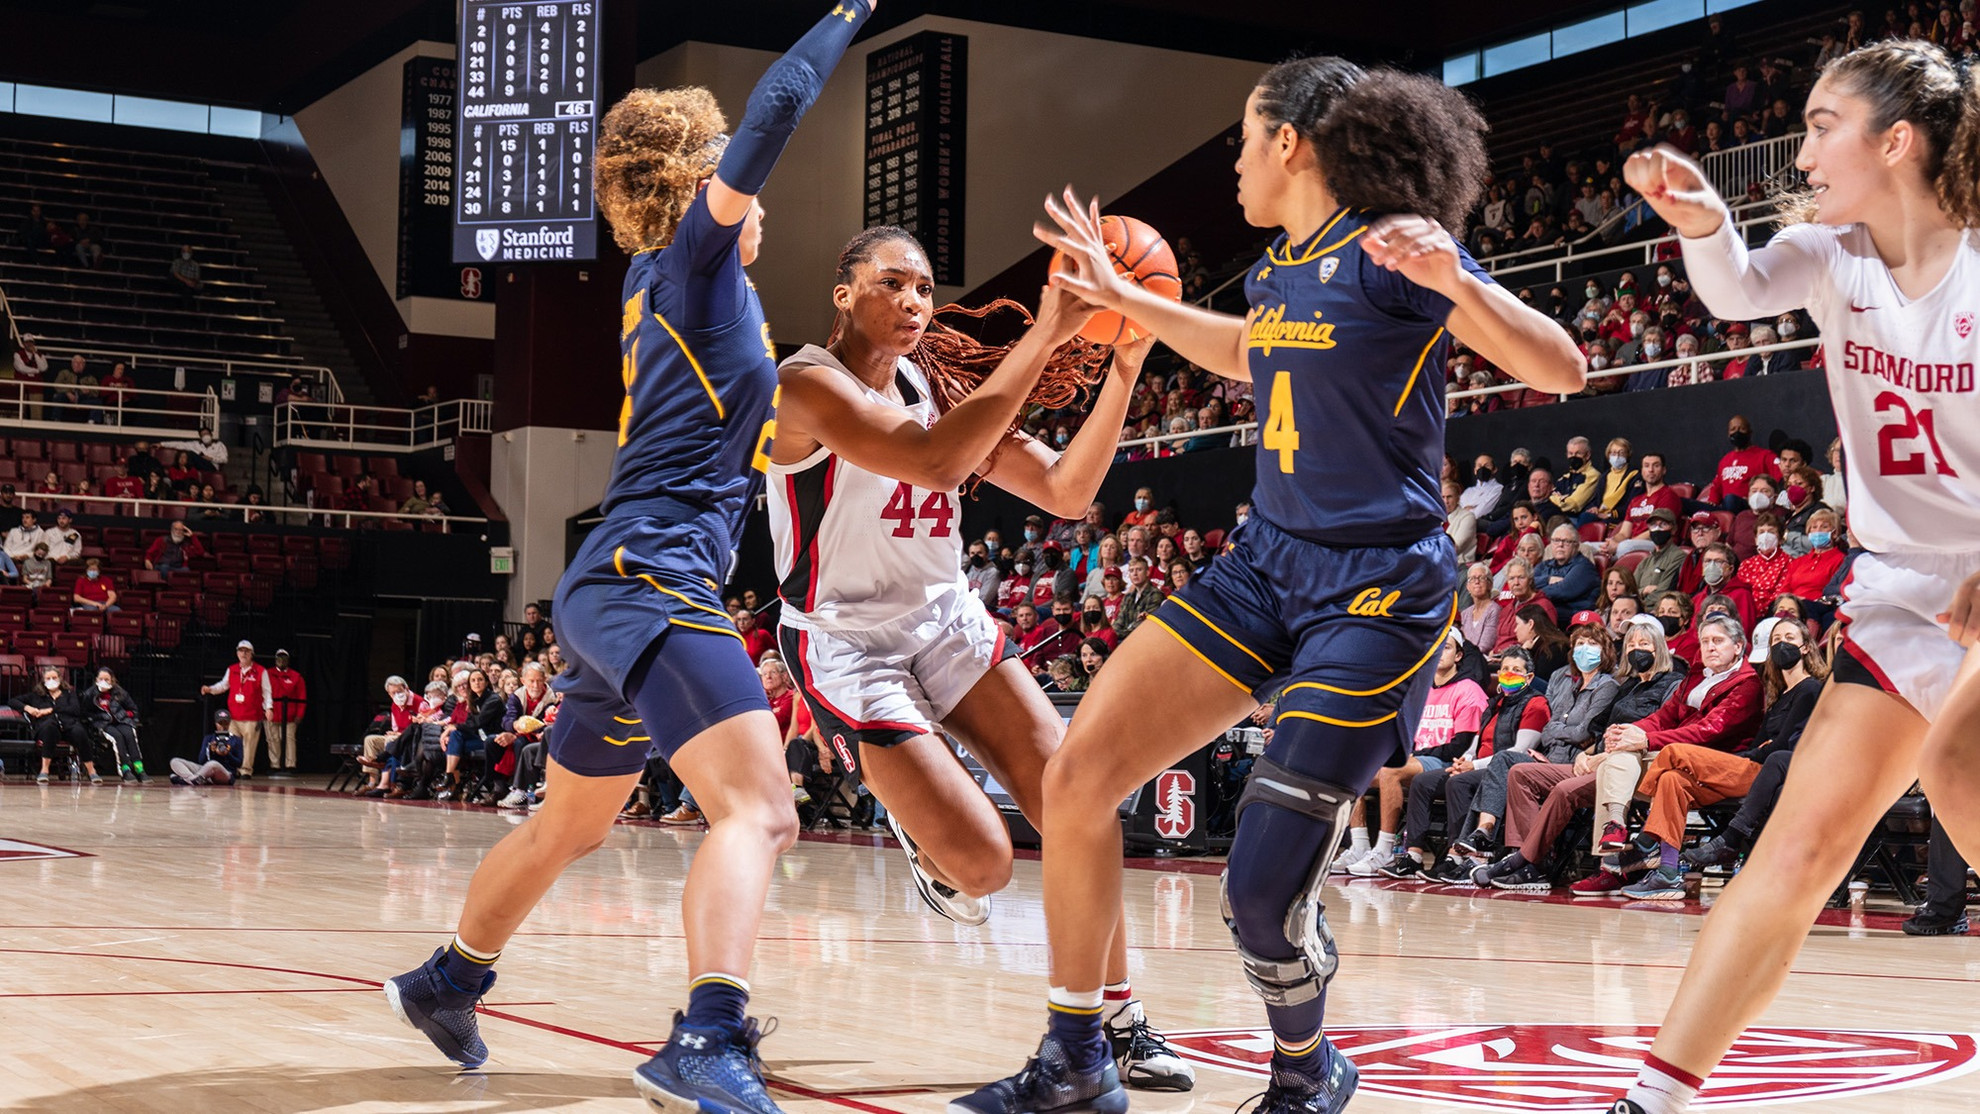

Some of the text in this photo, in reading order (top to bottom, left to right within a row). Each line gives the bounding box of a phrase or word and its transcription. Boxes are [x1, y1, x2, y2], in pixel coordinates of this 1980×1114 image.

[477, 3, 592, 21] # PTS REB FLS
[477, 20, 586, 37] 2 0 4 2
[470, 36, 585, 53] 10 4 2 1
[470, 51, 585, 68] 21 0 0 0
[469, 66, 585, 83] 33 8 2 0
[467, 81, 584, 98] 44 9 6 1
[428, 93, 452, 105] 1977
[427, 107, 452, 120] 1987
[464, 103, 585, 118] CALIFORNIA 46
[427, 122, 452, 134] 1995
[474, 121, 589, 138] # PTS REB FLS
[426, 136, 452, 148] 1998
[474, 137, 581, 153] 1 15 1 1
[424, 150, 452, 163] 2006
[472, 152, 582, 168] 4 0 1 0
[424, 164, 452, 177] 2009
[465, 167, 580, 183] 21 3 1 1
[424, 179, 450, 191] 2014
[465, 183, 580, 198] 24 7 3 1
[424, 193, 450, 206] 2019
[464, 199, 580, 215] 30 8 1 1
[503, 226, 574, 246] Stanford
[503, 246, 574, 259] MEDICINE
[1262, 370, 1300, 475] 4
[1874, 390, 1960, 480] 21
[880, 480, 954, 539] 44
[494, 558, 509, 572] EXIT
[1347, 586, 1402, 618] Cal
